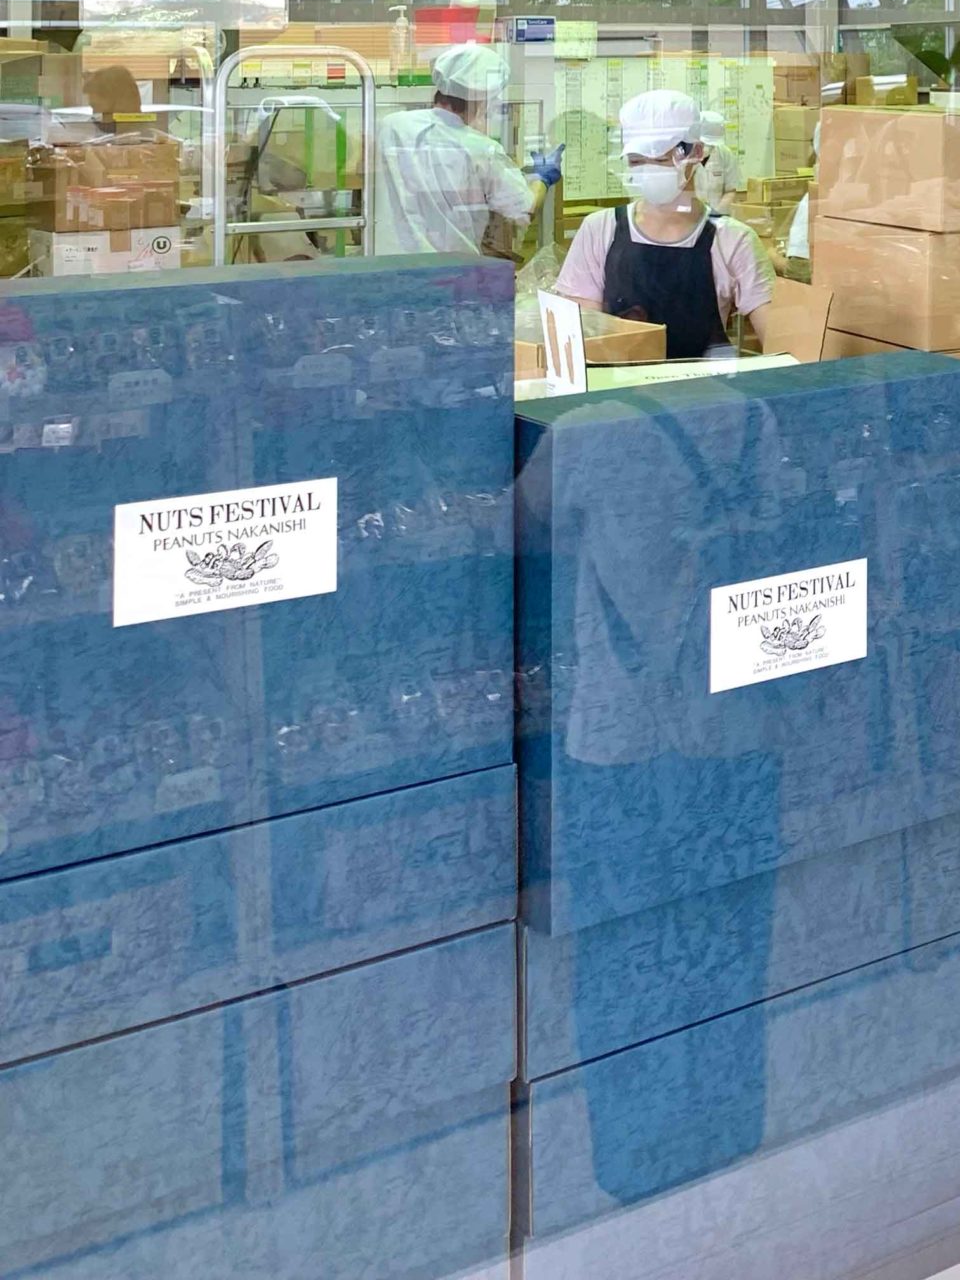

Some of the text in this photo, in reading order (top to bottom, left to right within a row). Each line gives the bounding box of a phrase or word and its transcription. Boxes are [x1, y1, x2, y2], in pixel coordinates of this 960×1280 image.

[138, 491, 321, 535] NUTS FESTIVAL
[153, 518, 307, 552] PEANUTS NAKANISHI
[727, 571, 856, 614] NUTS FESTIVAL
[737, 593, 846, 628] PEANUTS NAKANISHI
